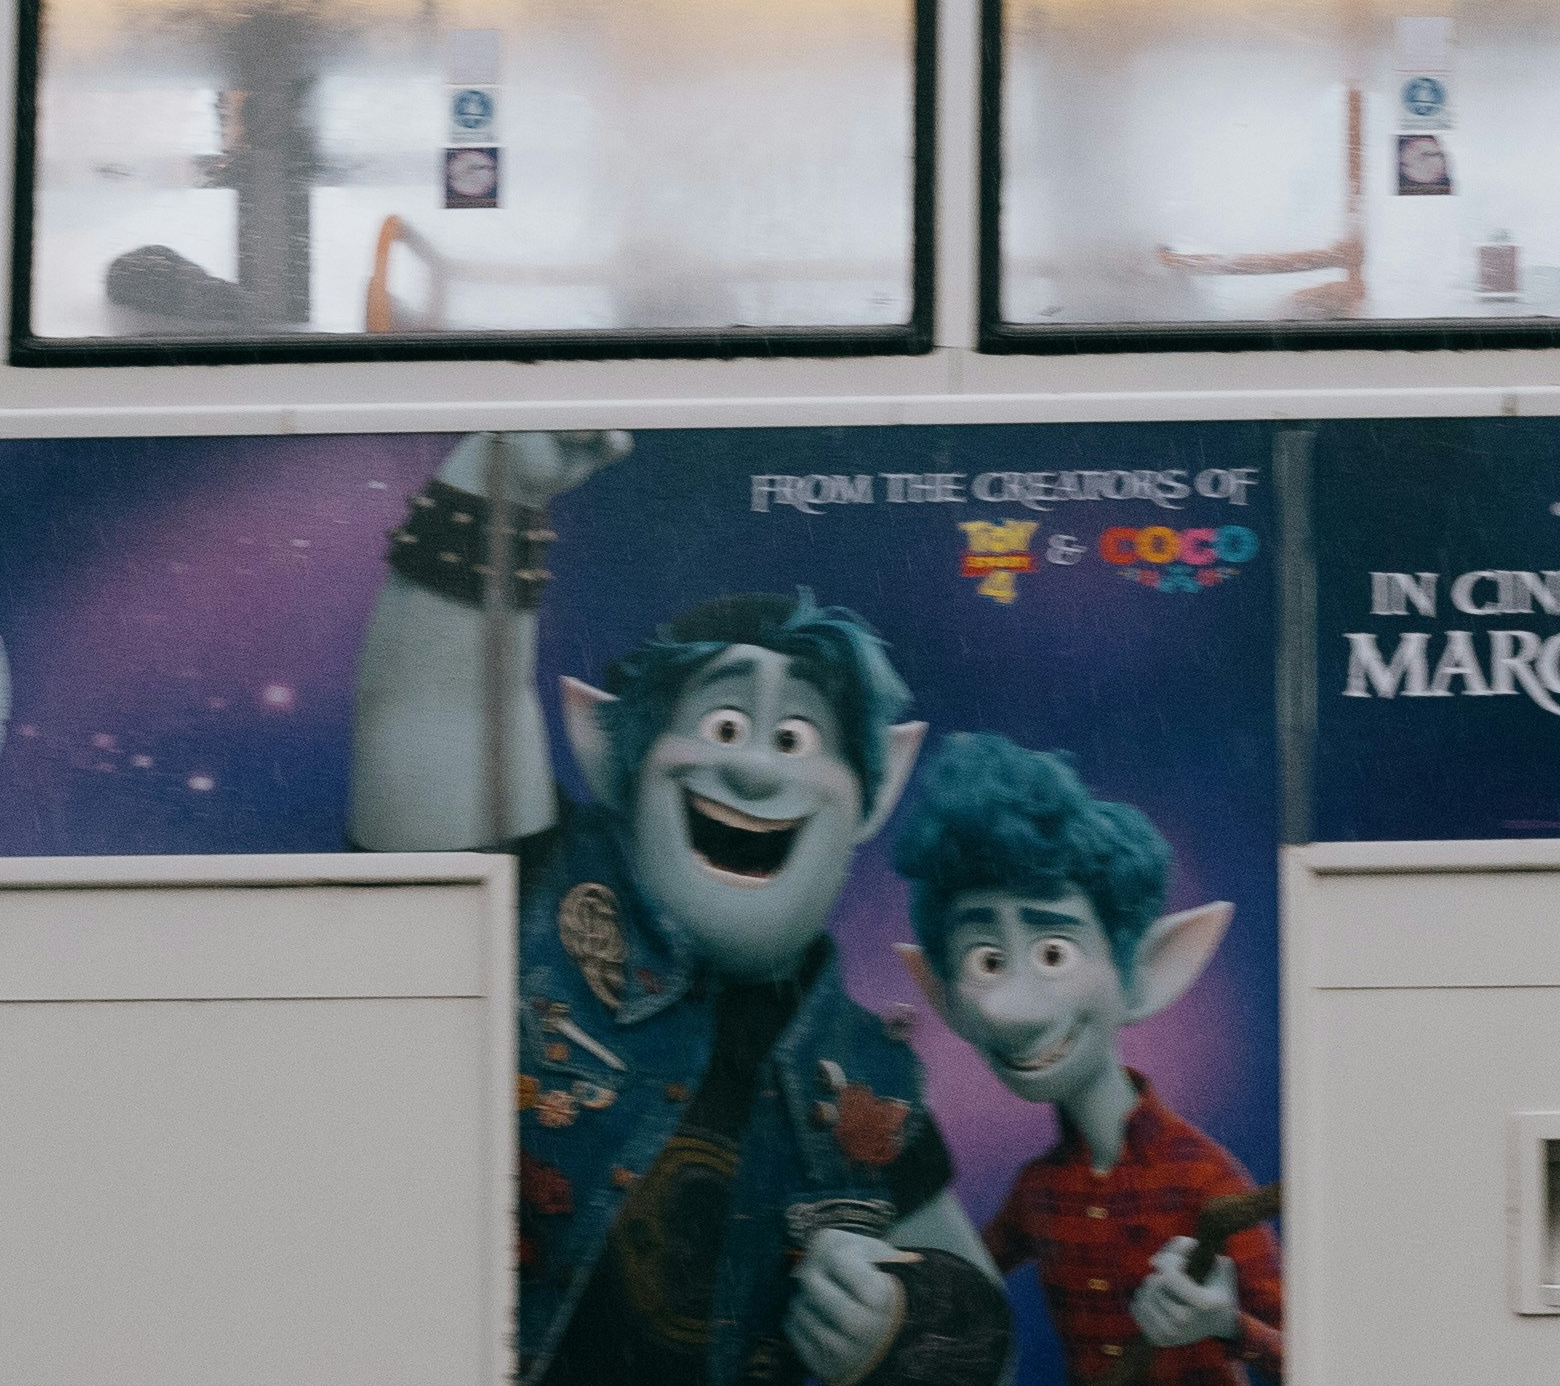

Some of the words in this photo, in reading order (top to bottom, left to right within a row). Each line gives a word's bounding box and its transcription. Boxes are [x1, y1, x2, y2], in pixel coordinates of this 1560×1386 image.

[750, 473, 874, 514] FROM
[878, 473, 968, 504] THE
[971, 469, 1194, 511] CREATORS
[1194, 468, 1261, 506] OF
[1099, 524, 1259, 565] COCO
[1368, 571, 1440, 618] IN
